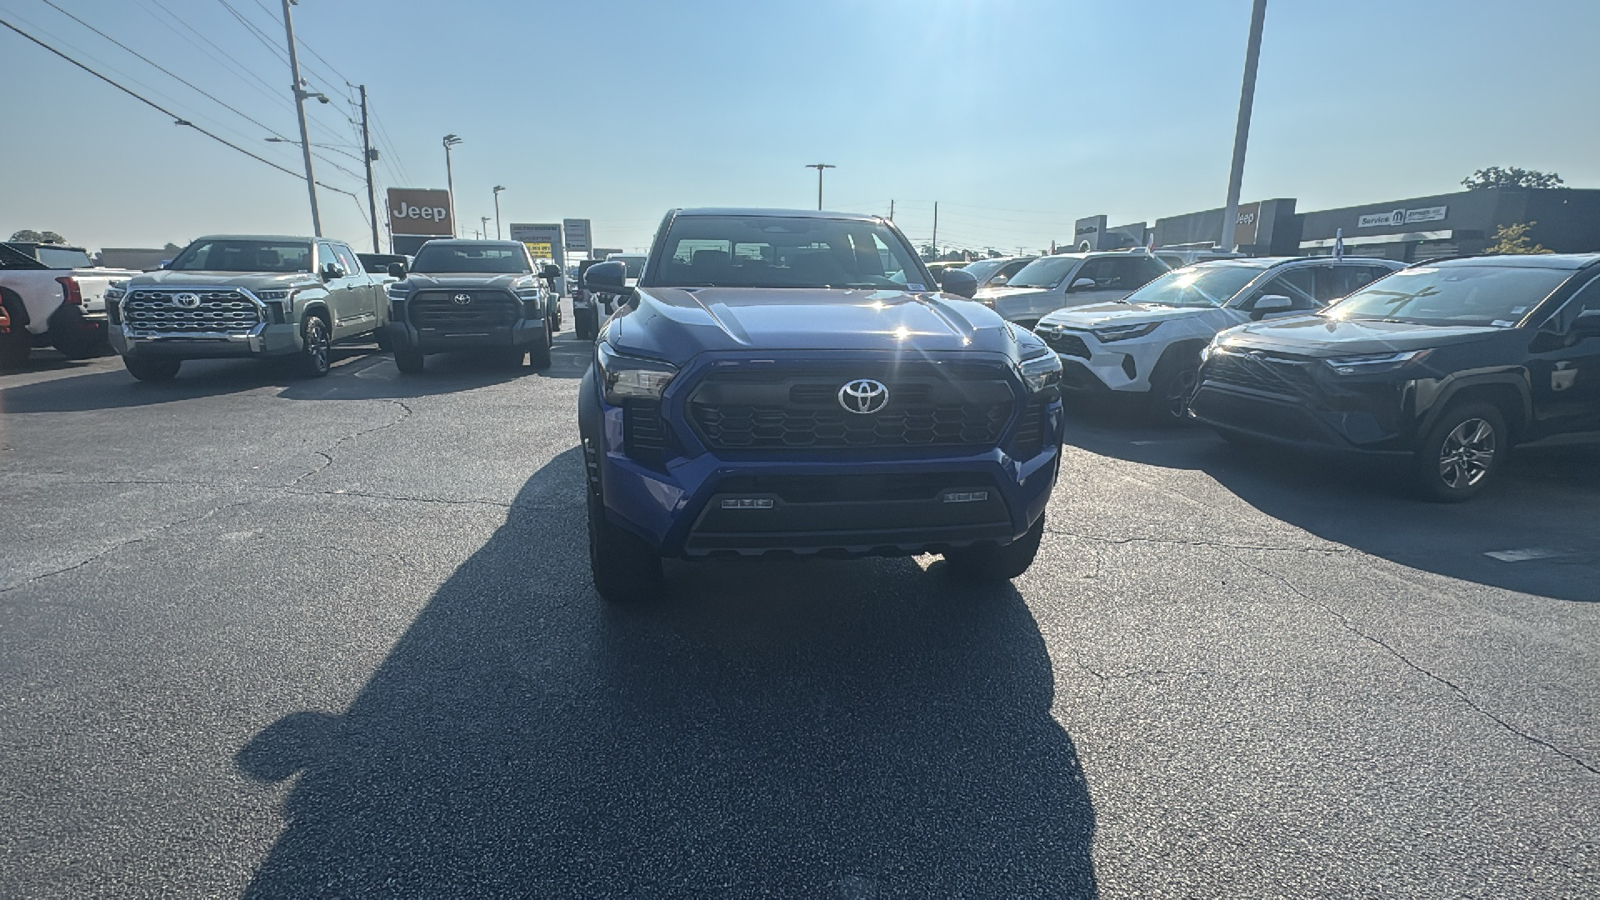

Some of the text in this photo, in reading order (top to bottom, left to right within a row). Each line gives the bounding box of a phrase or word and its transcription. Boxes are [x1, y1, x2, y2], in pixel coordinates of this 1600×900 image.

[393, 201, 446, 223] Jeep
[1236, 212, 1254, 225] Jeep
[1362, 215, 1390, 225] Service
